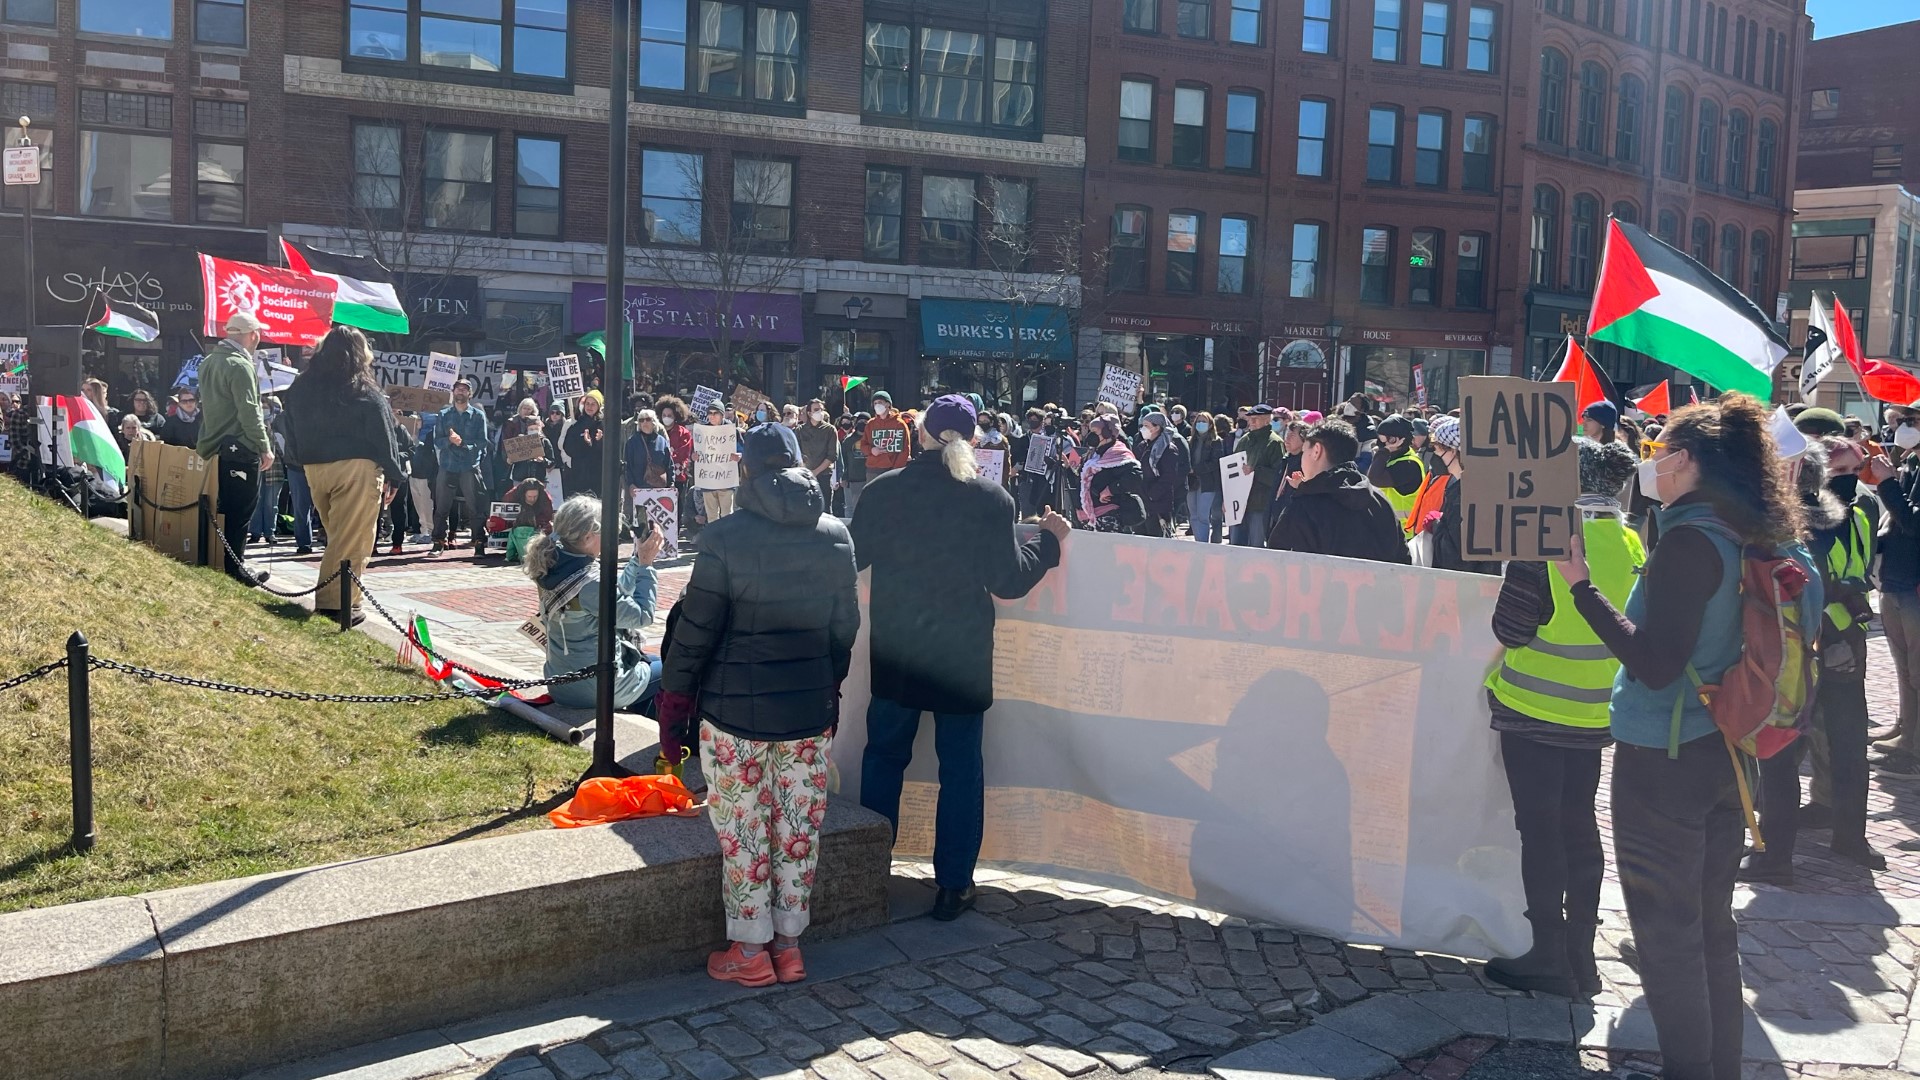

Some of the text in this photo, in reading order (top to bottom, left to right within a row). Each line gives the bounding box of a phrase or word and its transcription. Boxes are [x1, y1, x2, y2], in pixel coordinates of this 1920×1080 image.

[46, 266, 163, 305] SHAYS
[261, 282, 335, 300] Independent
[263, 295, 308, 309] Socialist
[418, 297, 469, 315] TEN
[263, 309, 294, 323] Group
[1110, 316, 1151, 326] FINE FOOD
[937, 323, 1004, 339] BURKE'S
[1560, 313, 1586, 335] FedE
[1284, 326, 1325, 337] MARKET
[1363, 330, 1391, 340] HOUSE
[1444, 334, 1483, 342] BEVERAGES
[949, 349, 986, 358] BREAKFAST
[433, 359, 447, 369] FREE
[473, 360, 505, 374] THE
[549, 356, 577, 368] PALESTINE
[550, 365, 579, 378] WILL BE
[1109, 365, 1138, 381] ISRAEL
[552, 377, 582, 395] FREE!
[1105, 373, 1139, 388] COMMITS
[1112, 381, 1131, 391] NEW
[1102, 385, 1137, 401] ATROCITIE
[1464, 390, 1572, 460] LAND
[705, 434, 727, 446] ARMS
[872, 429, 904, 438] LIFT THE
[873, 437, 902, 452] SIEGE
[698, 468, 733, 480] REGIME
[1508, 470, 1534, 500] IS
[492, 503, 520, 513] FREE
[643, 497, 675, 531] FREE
[1466, 503, 1576, 557] LIFE!
[521, 621, 541, 637] END
